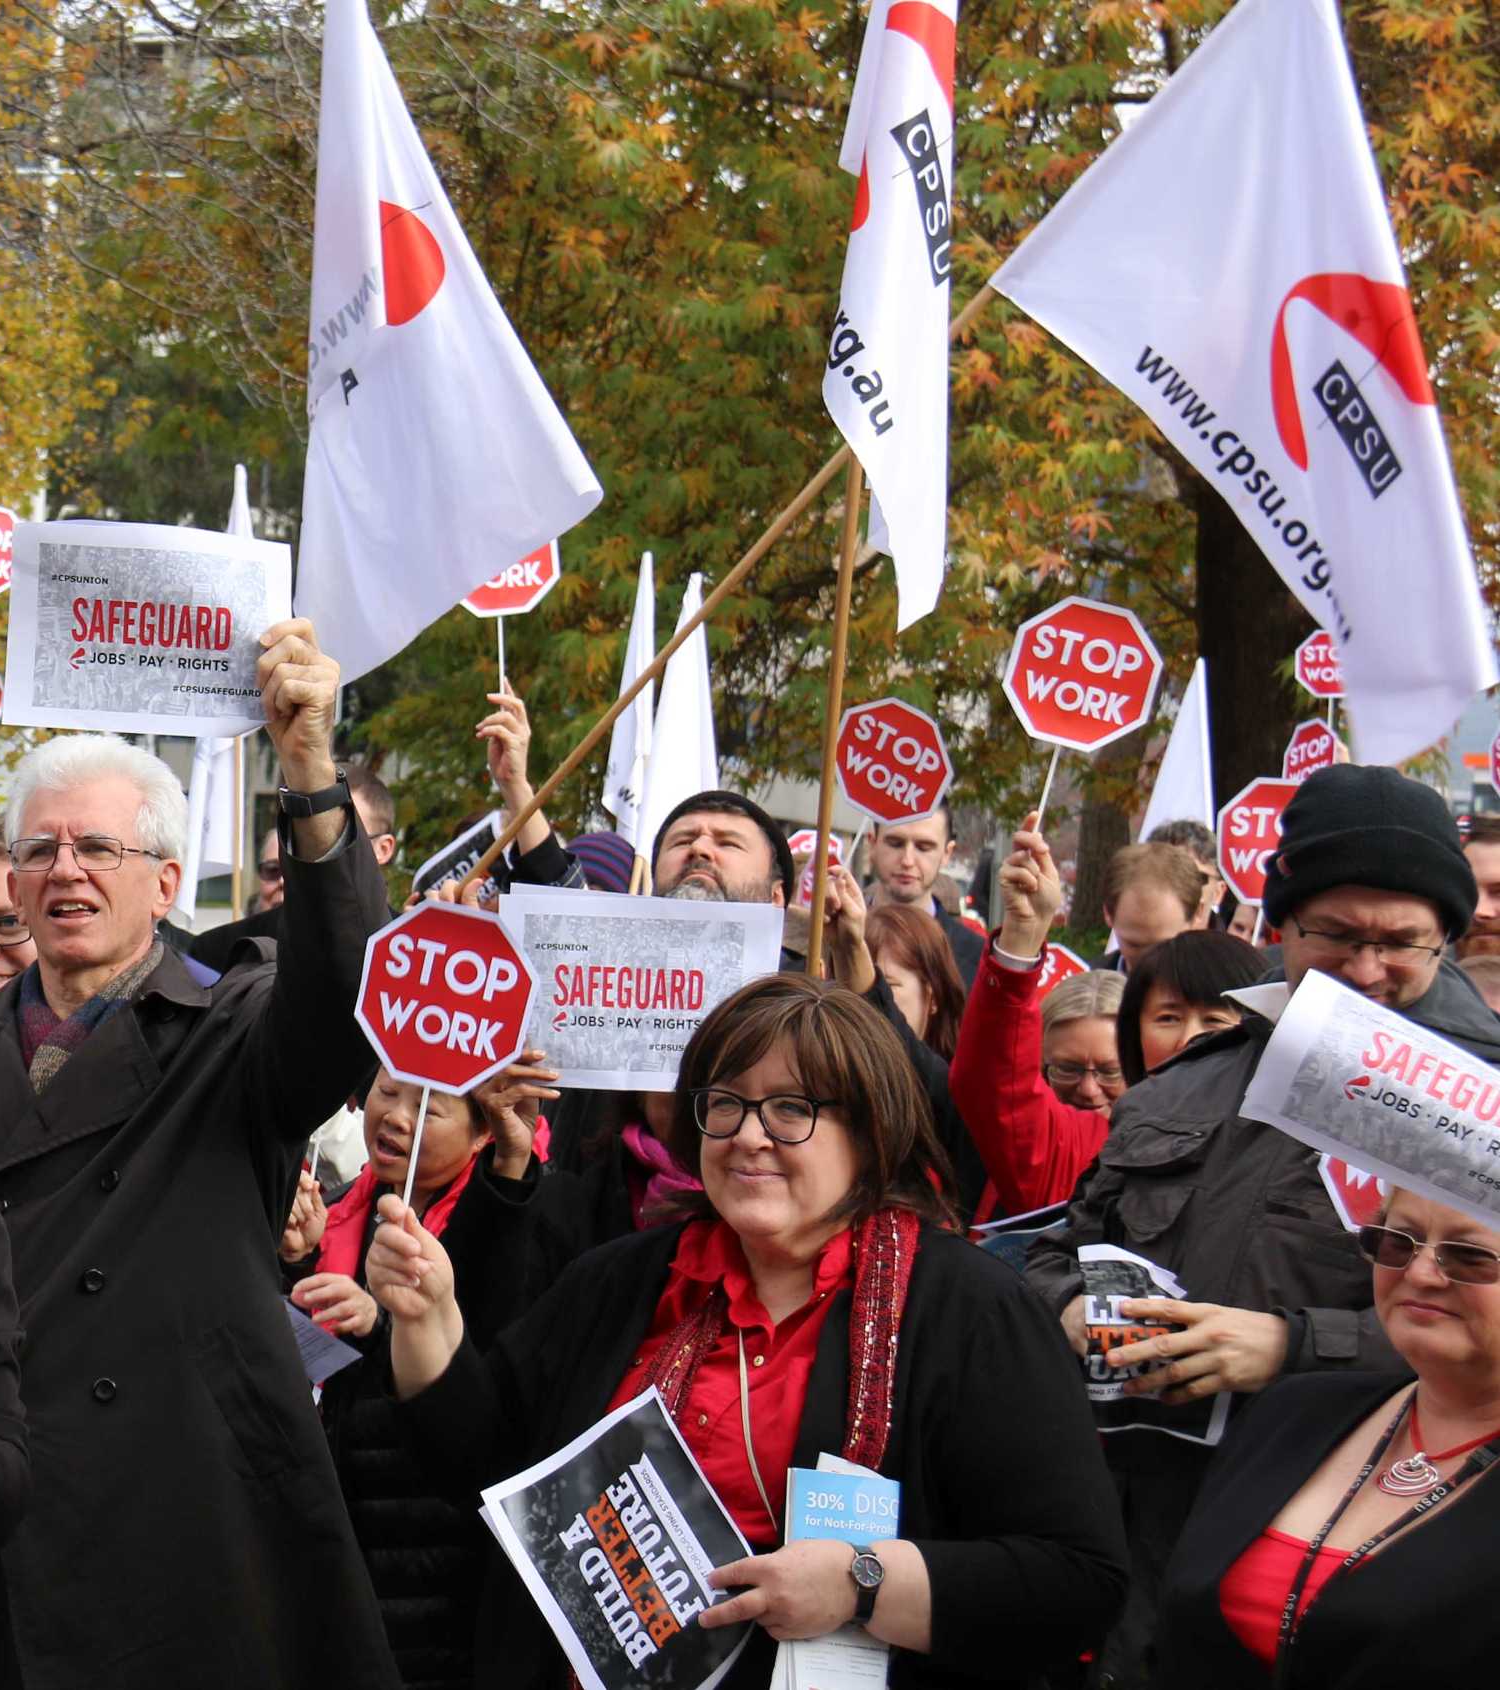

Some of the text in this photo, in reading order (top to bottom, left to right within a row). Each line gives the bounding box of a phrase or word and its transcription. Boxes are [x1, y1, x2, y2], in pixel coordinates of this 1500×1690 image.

[905, 122, 950, 277] CPSU
[1320, 371, 1400, 491] CPSU
[1134, 344, 1353, 645] www.cpsu.org.
[51, 574, 109, 585] #CPSUNION
[71, 597, 232, 651] SAFEGUARD
[90, 652, 229, 672] JOBS PAY RIGHTS
[1032, 625, 1143, 680] STOP
[172, 685, 262, 698] #CPSUSAFEGUARD
[1026, 670, 1131, 726] WORK
[854, 714, 942, 776] STOP
[1290, 734, 1330, 766] STOP
[845, 745, 927, 813] WORK
[1230, 806, 1283, 838] ST
[386, 933, 519, 1003] STOP
[534, 943, 589, 952] #CPSUNION
[553, 964, 704, 1010] SAFEGUARD
[380, 991, 504, 1063] WORK
[570, 1015, 701, 1031] JOBS PAY RIGHTS
[1362, 1031, 1500, 1128] SAFEGU
[1370, 1087, 1474, 1142] JOBS PAY
[805, 1515, 821, 1526] for
[806, 1491, 845, 1511] 30%
[1414, 1486, 1447, 1512] CPSU
[586, 1492, 682, 1649] BETTER
[605, 1472, 706, 1628] FUTURE
[559, 1512, 659, 1670] BUILD A
[1280, 1593, 1297, 1630] CPSU
